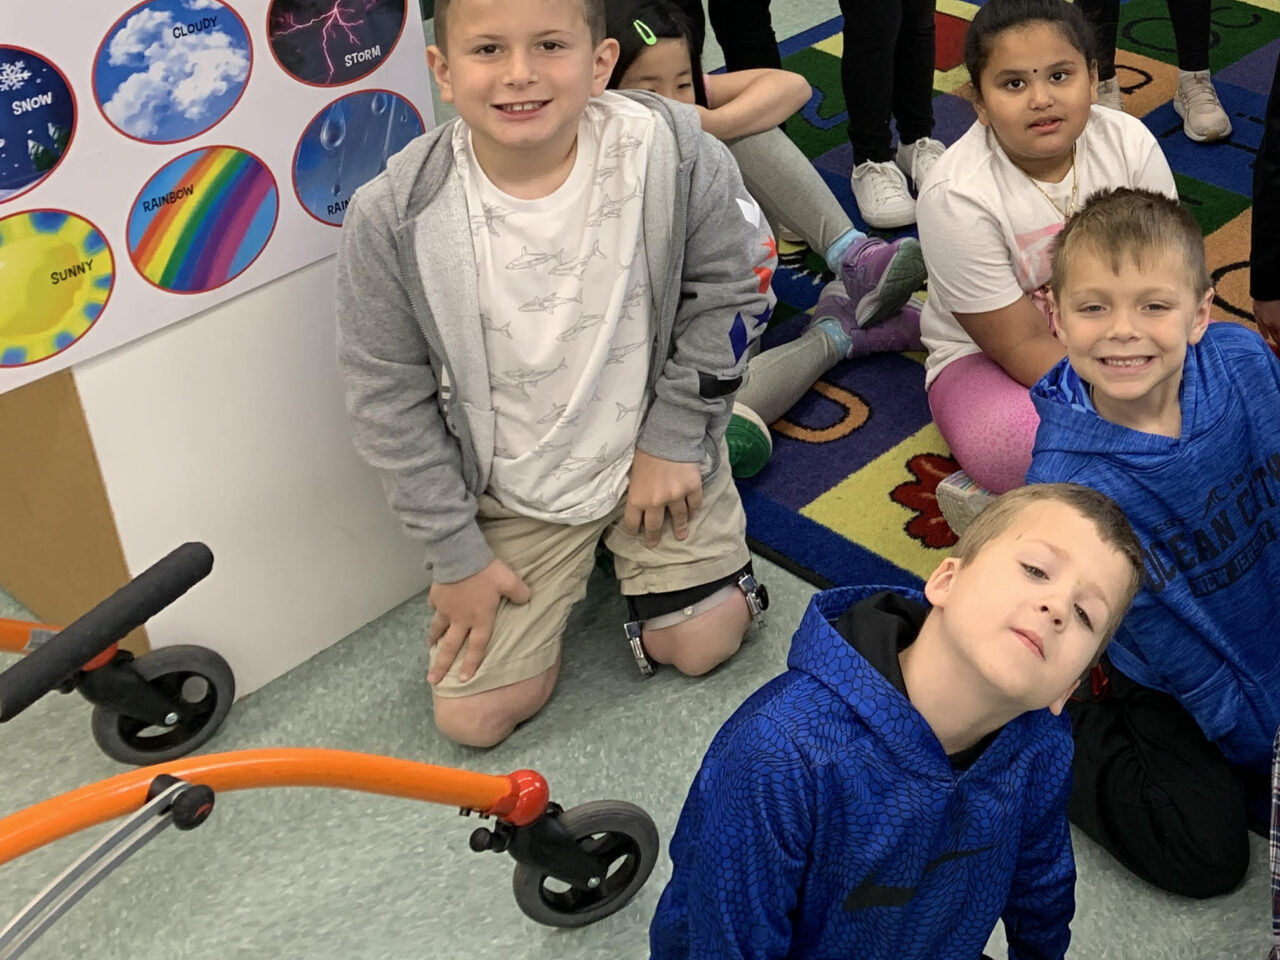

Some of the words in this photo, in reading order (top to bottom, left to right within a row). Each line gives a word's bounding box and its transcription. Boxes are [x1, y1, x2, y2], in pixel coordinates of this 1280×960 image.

[172, 16, 218, 40] CLOUDY
[344, 45, 382, 67] STORM
[11, 91, 53, 116] SNOW
[143, 184, 195, 212] RAINBOW
[50, 259, 94, 285] SUNNY
[1143, 510, 1237, 593] OCEAN
